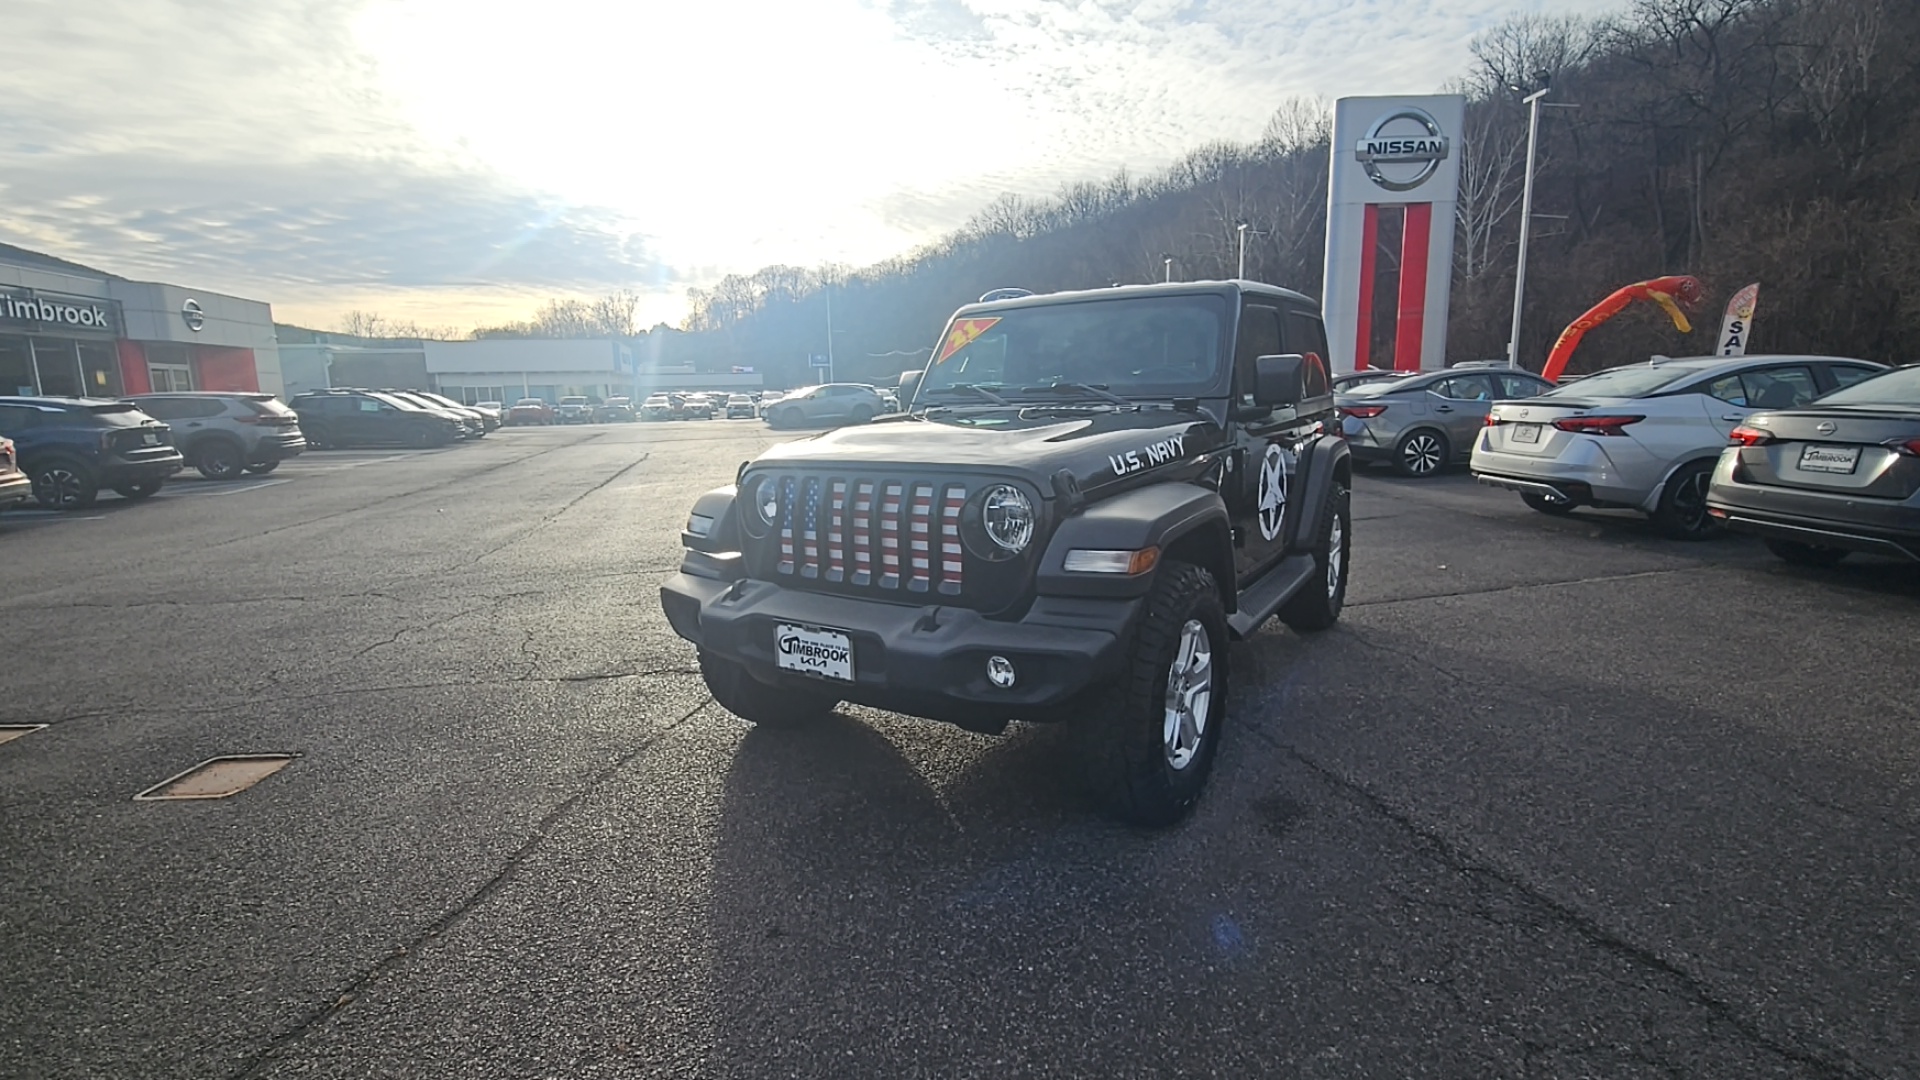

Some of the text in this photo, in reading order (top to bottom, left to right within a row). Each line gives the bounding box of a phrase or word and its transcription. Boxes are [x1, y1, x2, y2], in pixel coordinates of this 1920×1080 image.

[1366, 140, 1442, 154] NISSAN
[1108, 436, 1185, 476] U.S. NAVY
[779, 634, 848, 664] TIMBROOK
[800, 656, 827, 668] KIA
